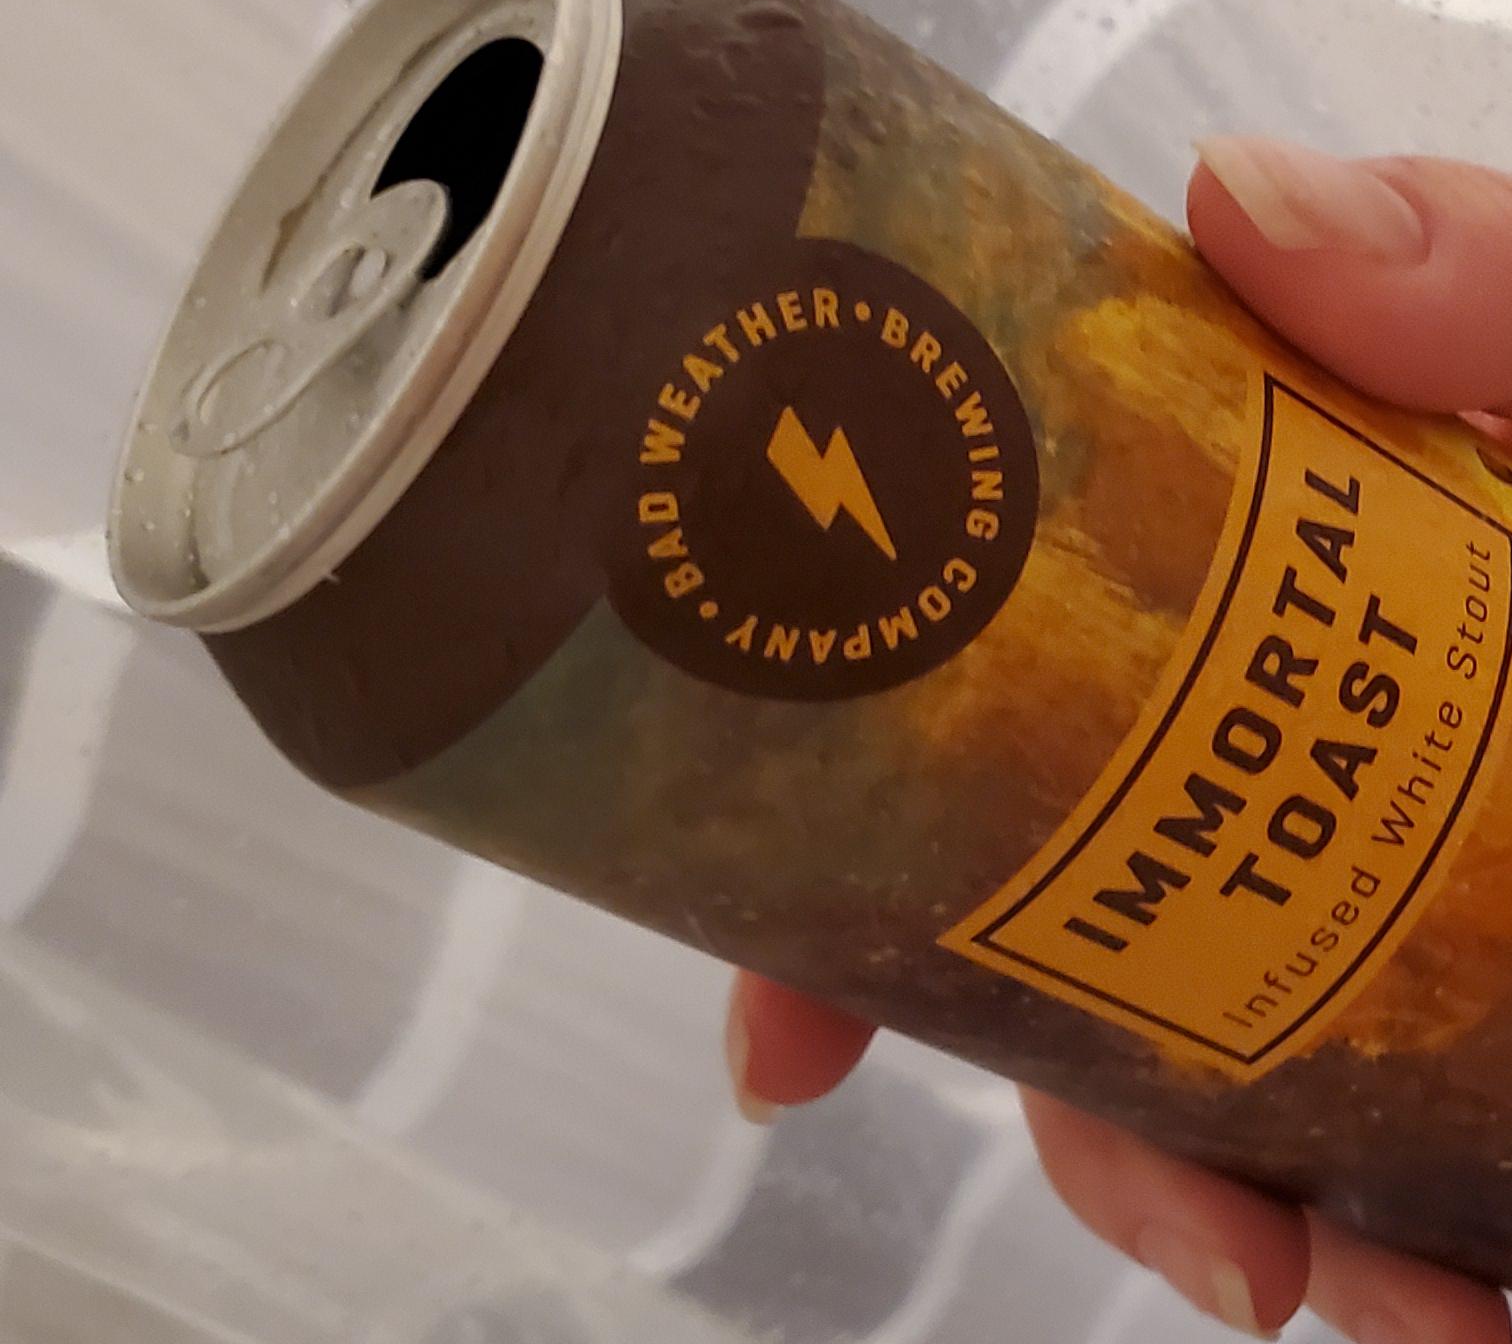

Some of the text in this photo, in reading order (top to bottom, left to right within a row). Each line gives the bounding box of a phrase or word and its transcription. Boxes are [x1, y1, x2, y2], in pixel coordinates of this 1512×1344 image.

[639, 287, 1003, 664] BAD WEATHER BREWING COMPANY
[1063, 467, 1362, 953] IMMORTAL
[1220, 594, 1418, 908] TOAST
[1223, 541, 1492, 1029] Infused White Stout
